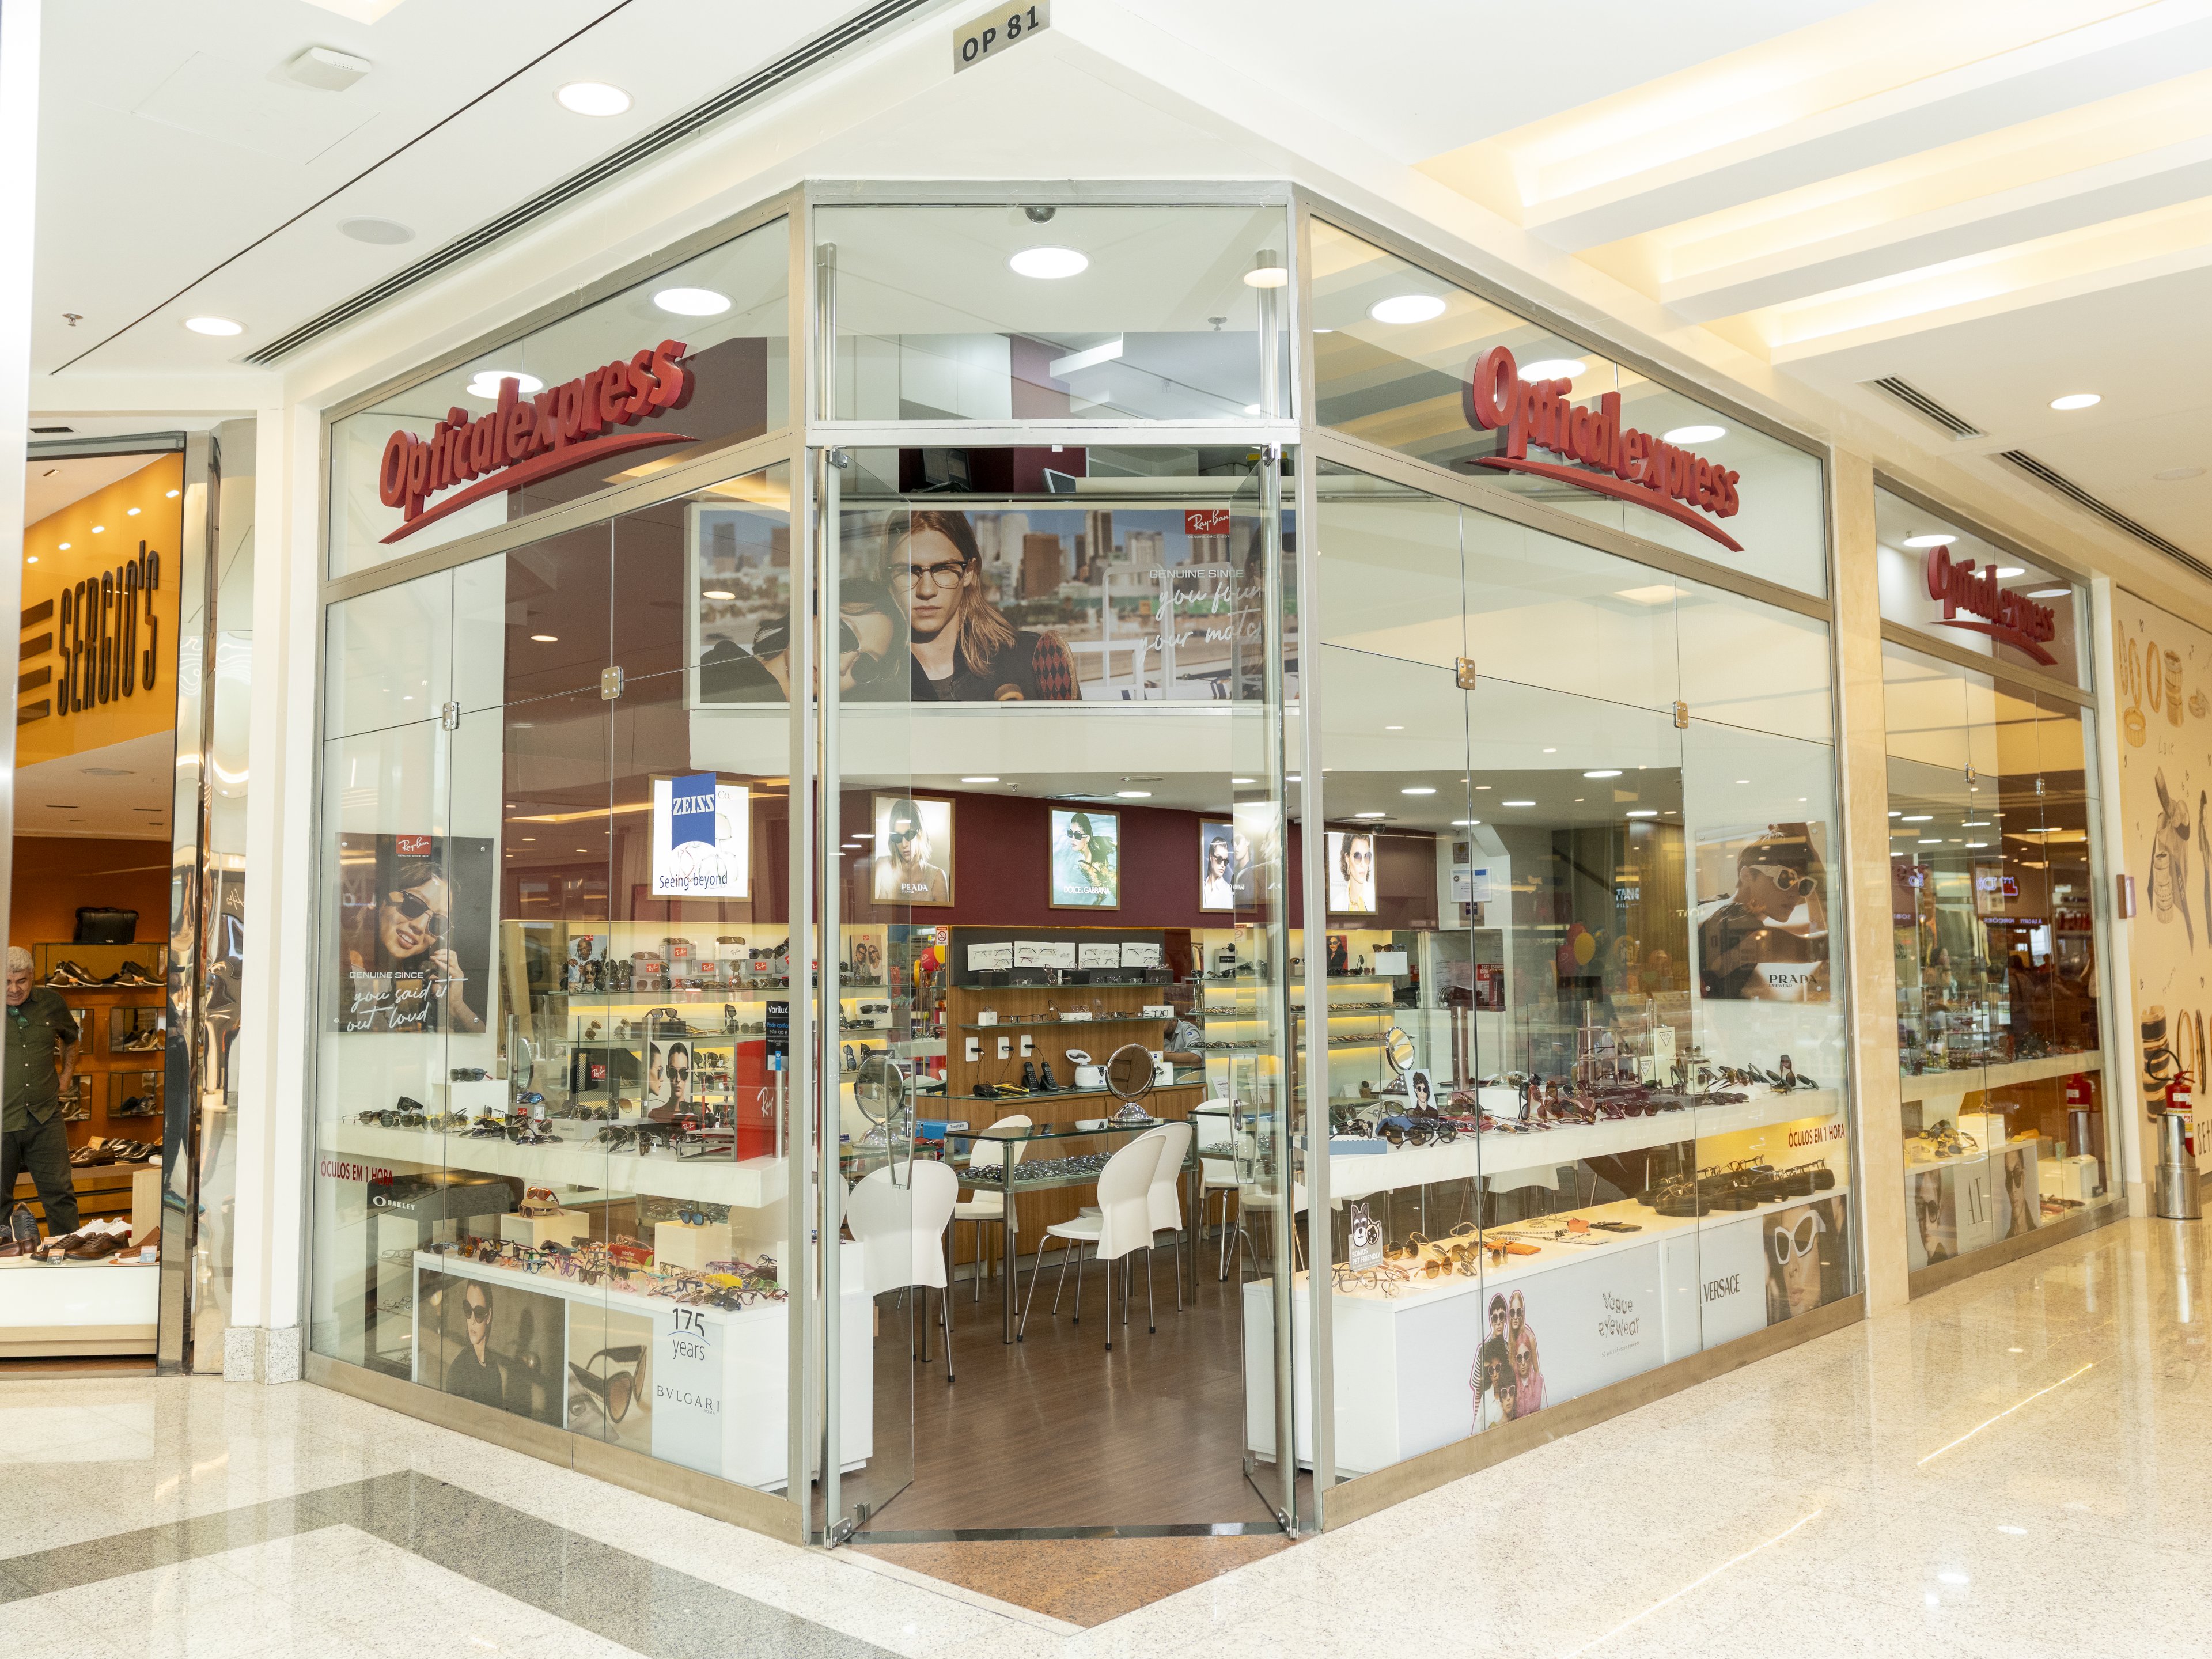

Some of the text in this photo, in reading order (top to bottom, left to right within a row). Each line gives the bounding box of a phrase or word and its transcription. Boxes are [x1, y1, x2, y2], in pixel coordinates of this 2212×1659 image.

[963, 6, 1039, 62] OP 81
[1149, 569, 1244, 578] GENUINE SINCE
[1156, 581, 1261, 622] you foun
[1139, 631, 1194, 668] your
[672, 794, 714, 816] ZEISS
[660, 870, 728, 891] Seeing beyond
[901, 883, 929, 891] PRADA
[1769, 975, 1817, 984] PRADA
[350, 975, 468, 1013] you said it
[347, 1001, 430, 1032] out loud
[1788, 1123, 1845, 1148] ÓCULOS EM 1 HORA
[320, 1155, 393, 1187] ÓCULOS EM 1 HORA
[388, 1199, 415, 1210] OAKLEY
[1351, 1248, 1368, 1258] SOMOS
[1352, 1257, 1360, 1266] PET
[1361, 1251, 1381, 1263] FRIENDLY
[1703, 1274, 1740, 1302] VERSACE
[1603, 1291, 1633, 1315] Vogue
[672, 1308, 704, 1337] 175
[1598, 1315, 1640, 1338] eyewear
[673, 1339, 704, 1361] years
[1607, 1349, 1615, 1357] years
[657, 1385, 720, 1412] BVLGARI
